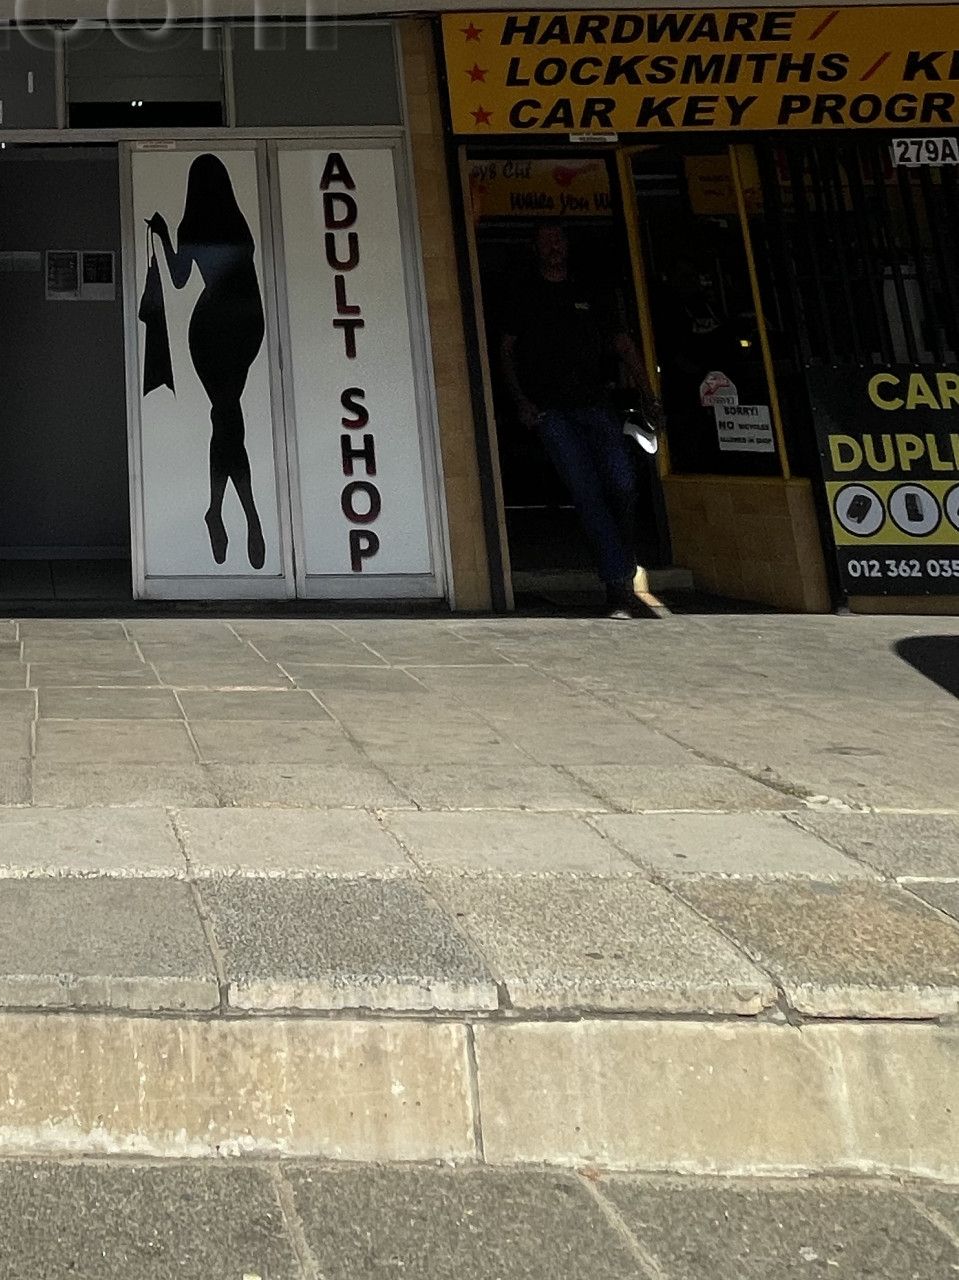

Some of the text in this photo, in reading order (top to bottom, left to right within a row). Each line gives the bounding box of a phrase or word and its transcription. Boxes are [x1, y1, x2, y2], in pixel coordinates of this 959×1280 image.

[500, 11, 797, 46] HARDWARE
[505, 51, 850, 87] LOCKSMITHS
[508, 91, 957, 129] CAR KEY PROGR
[896, 139, 958, 163] 279A
[319, 152, 381, 572] ADULT SHOP
[868, 373, 959, 410] CAR
[718, 421, 735, 430] NO
[847, 559, 882, 578] 012
[885, 559, 923, 578] 362
